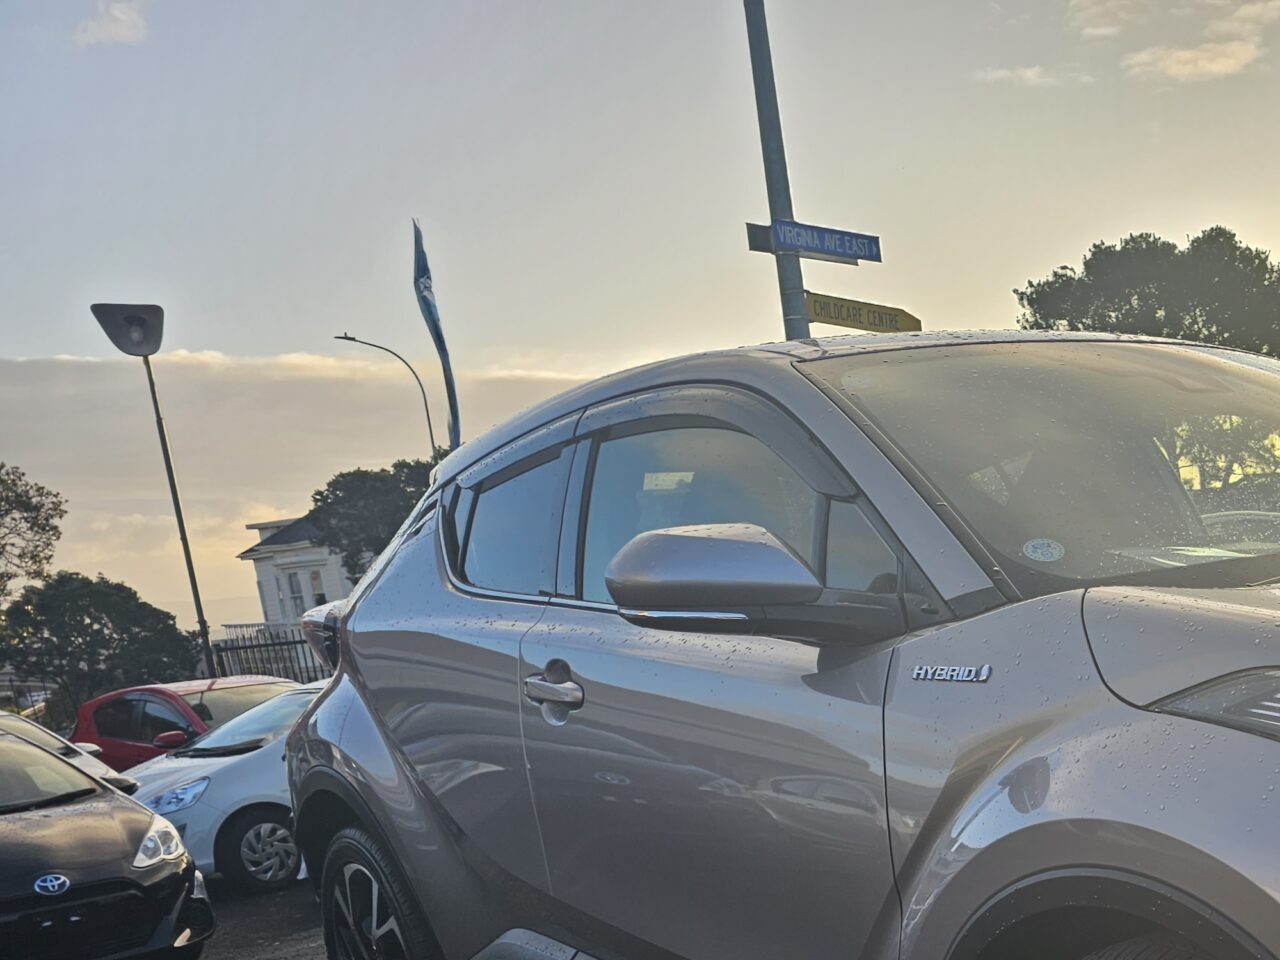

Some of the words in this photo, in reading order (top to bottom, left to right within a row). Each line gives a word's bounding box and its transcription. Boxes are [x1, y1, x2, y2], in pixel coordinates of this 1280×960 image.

[776, 224, 821, 248] VIRGINIA
[824, 233, 841, 251] AVE
[844, 236, 869, 257] EAST
[813, 300, 863, 324] CHILDCARE
[867, 309, 900, 330] CENTRE
[912, 665, 976, 681] HYBRID
